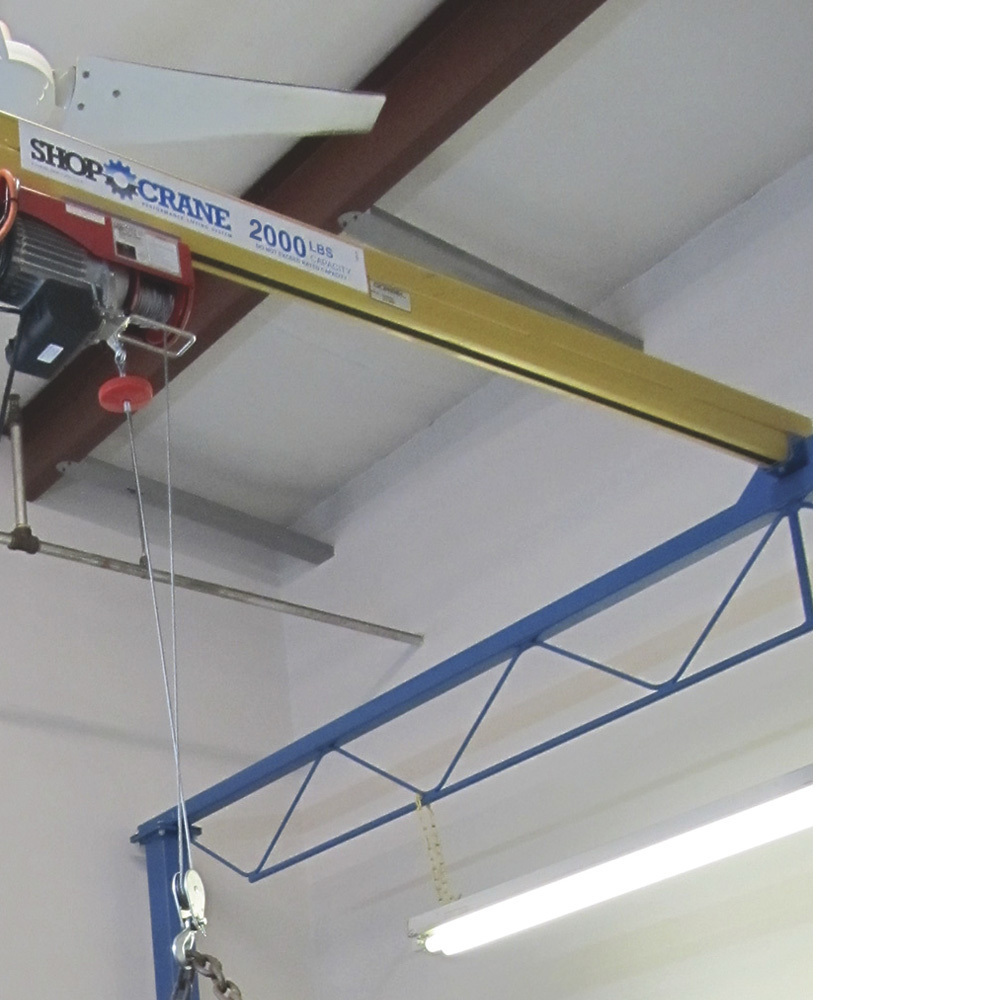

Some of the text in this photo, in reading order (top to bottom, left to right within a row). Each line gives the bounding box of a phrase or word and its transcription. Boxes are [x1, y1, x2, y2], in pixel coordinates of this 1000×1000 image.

[30, 137, 104, 182] SHOP
[137, 178, 232, 231] CRANE
[249, 218, 307, 259] 2000
[308, 240, 334, 259] LBS
[310, 254, 352, 275] CAPACITY
